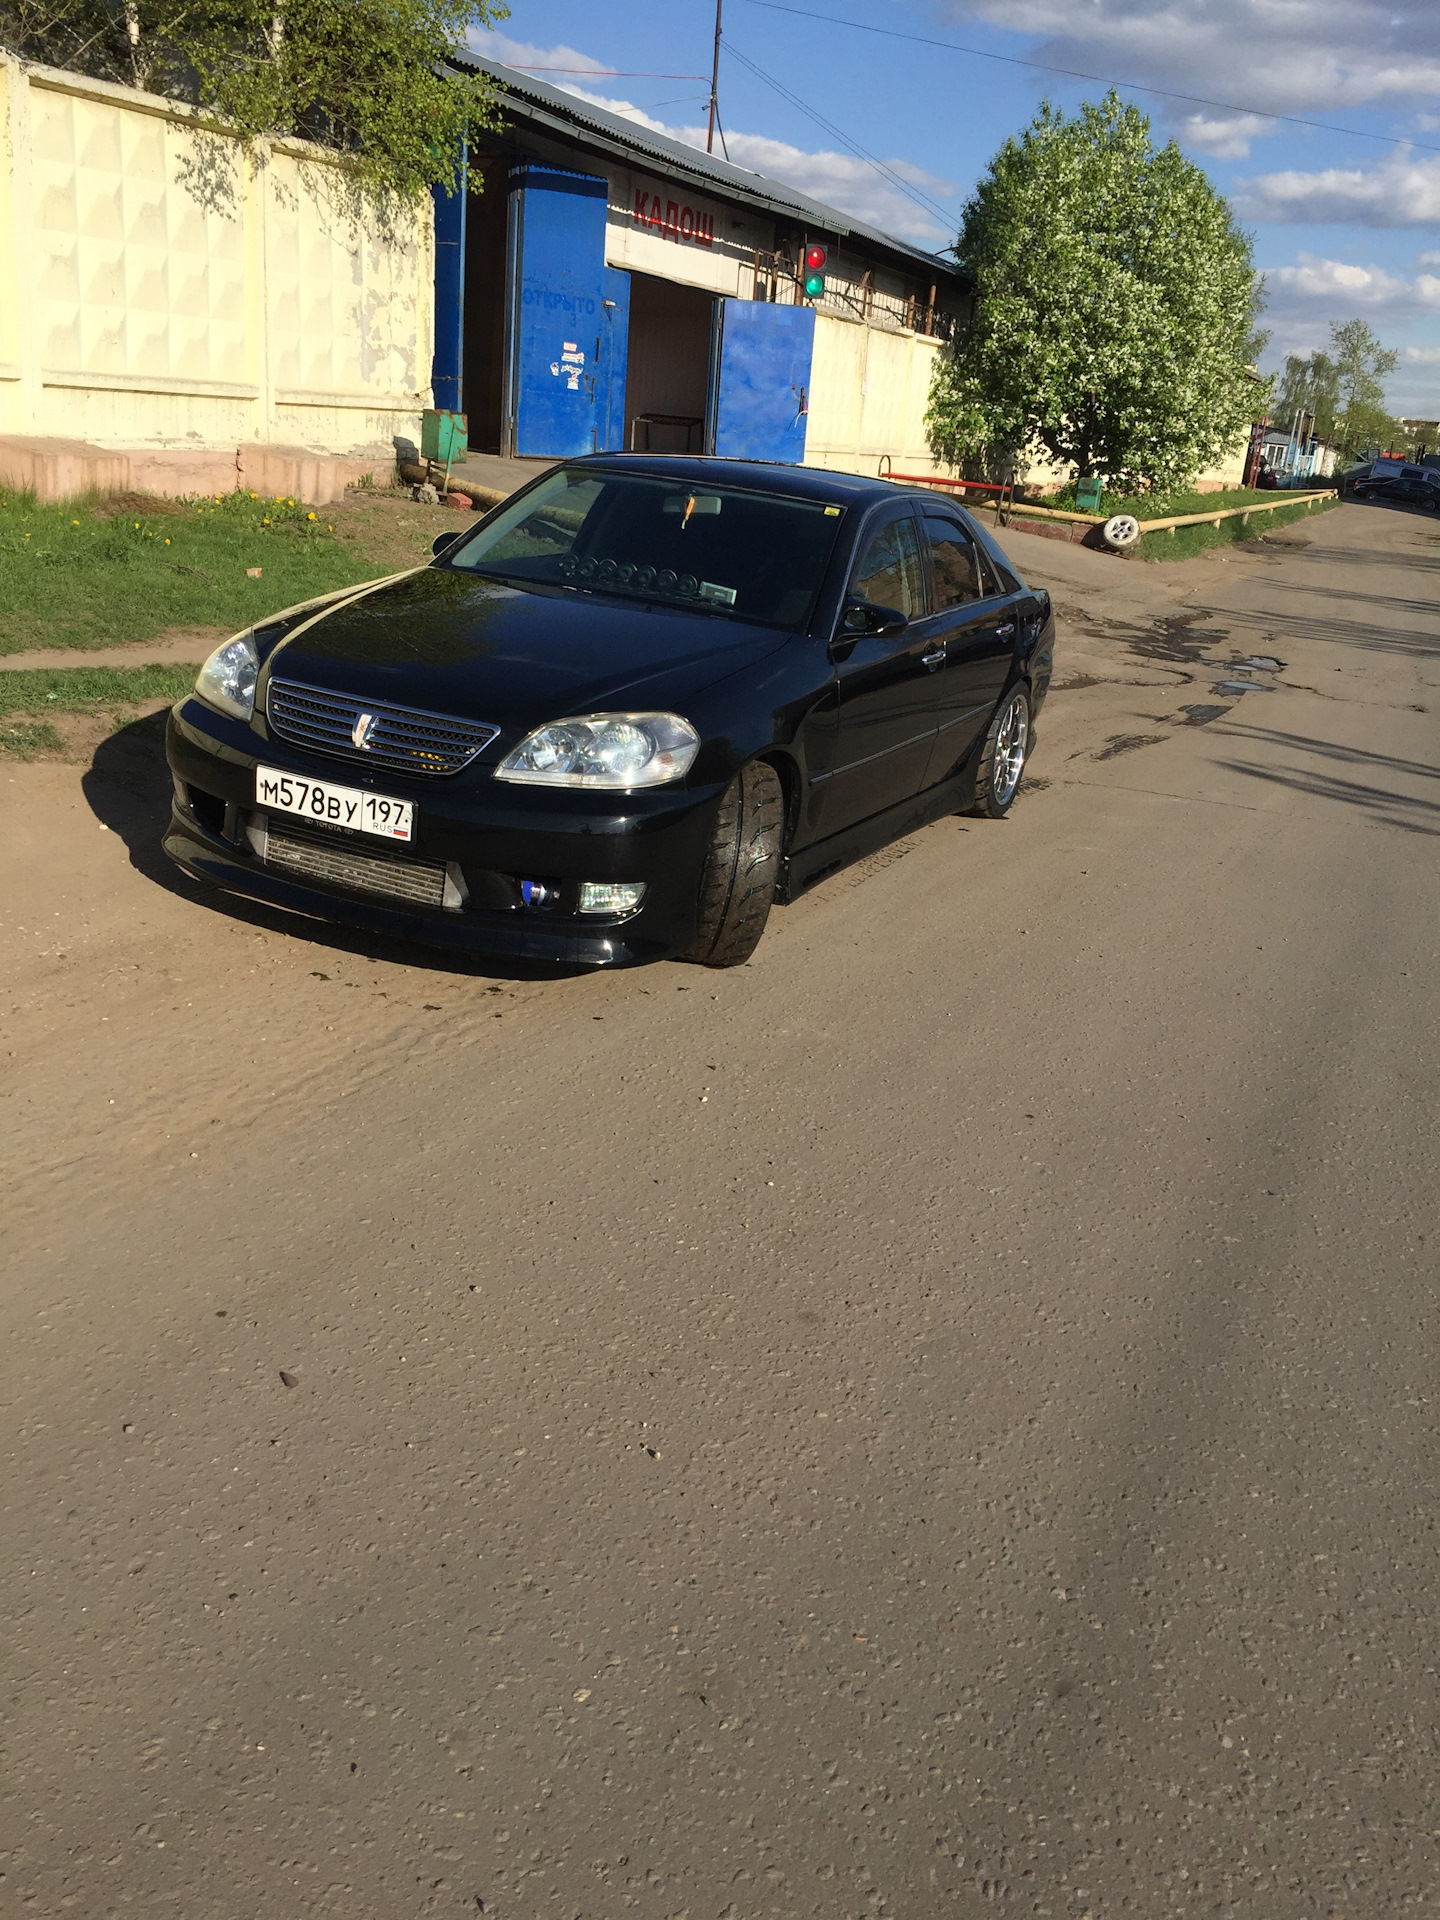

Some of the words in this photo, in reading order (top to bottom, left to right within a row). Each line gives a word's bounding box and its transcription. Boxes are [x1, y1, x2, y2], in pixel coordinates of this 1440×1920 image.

[634, 189, 714, 248] КАДОШ
[523, 288, 595, 315] ОТКРЫТО
[366, 798, 405, 825] 197
[315, 820, 342, 832] TOYOTA
[372, 821, 393, 834] RUS
